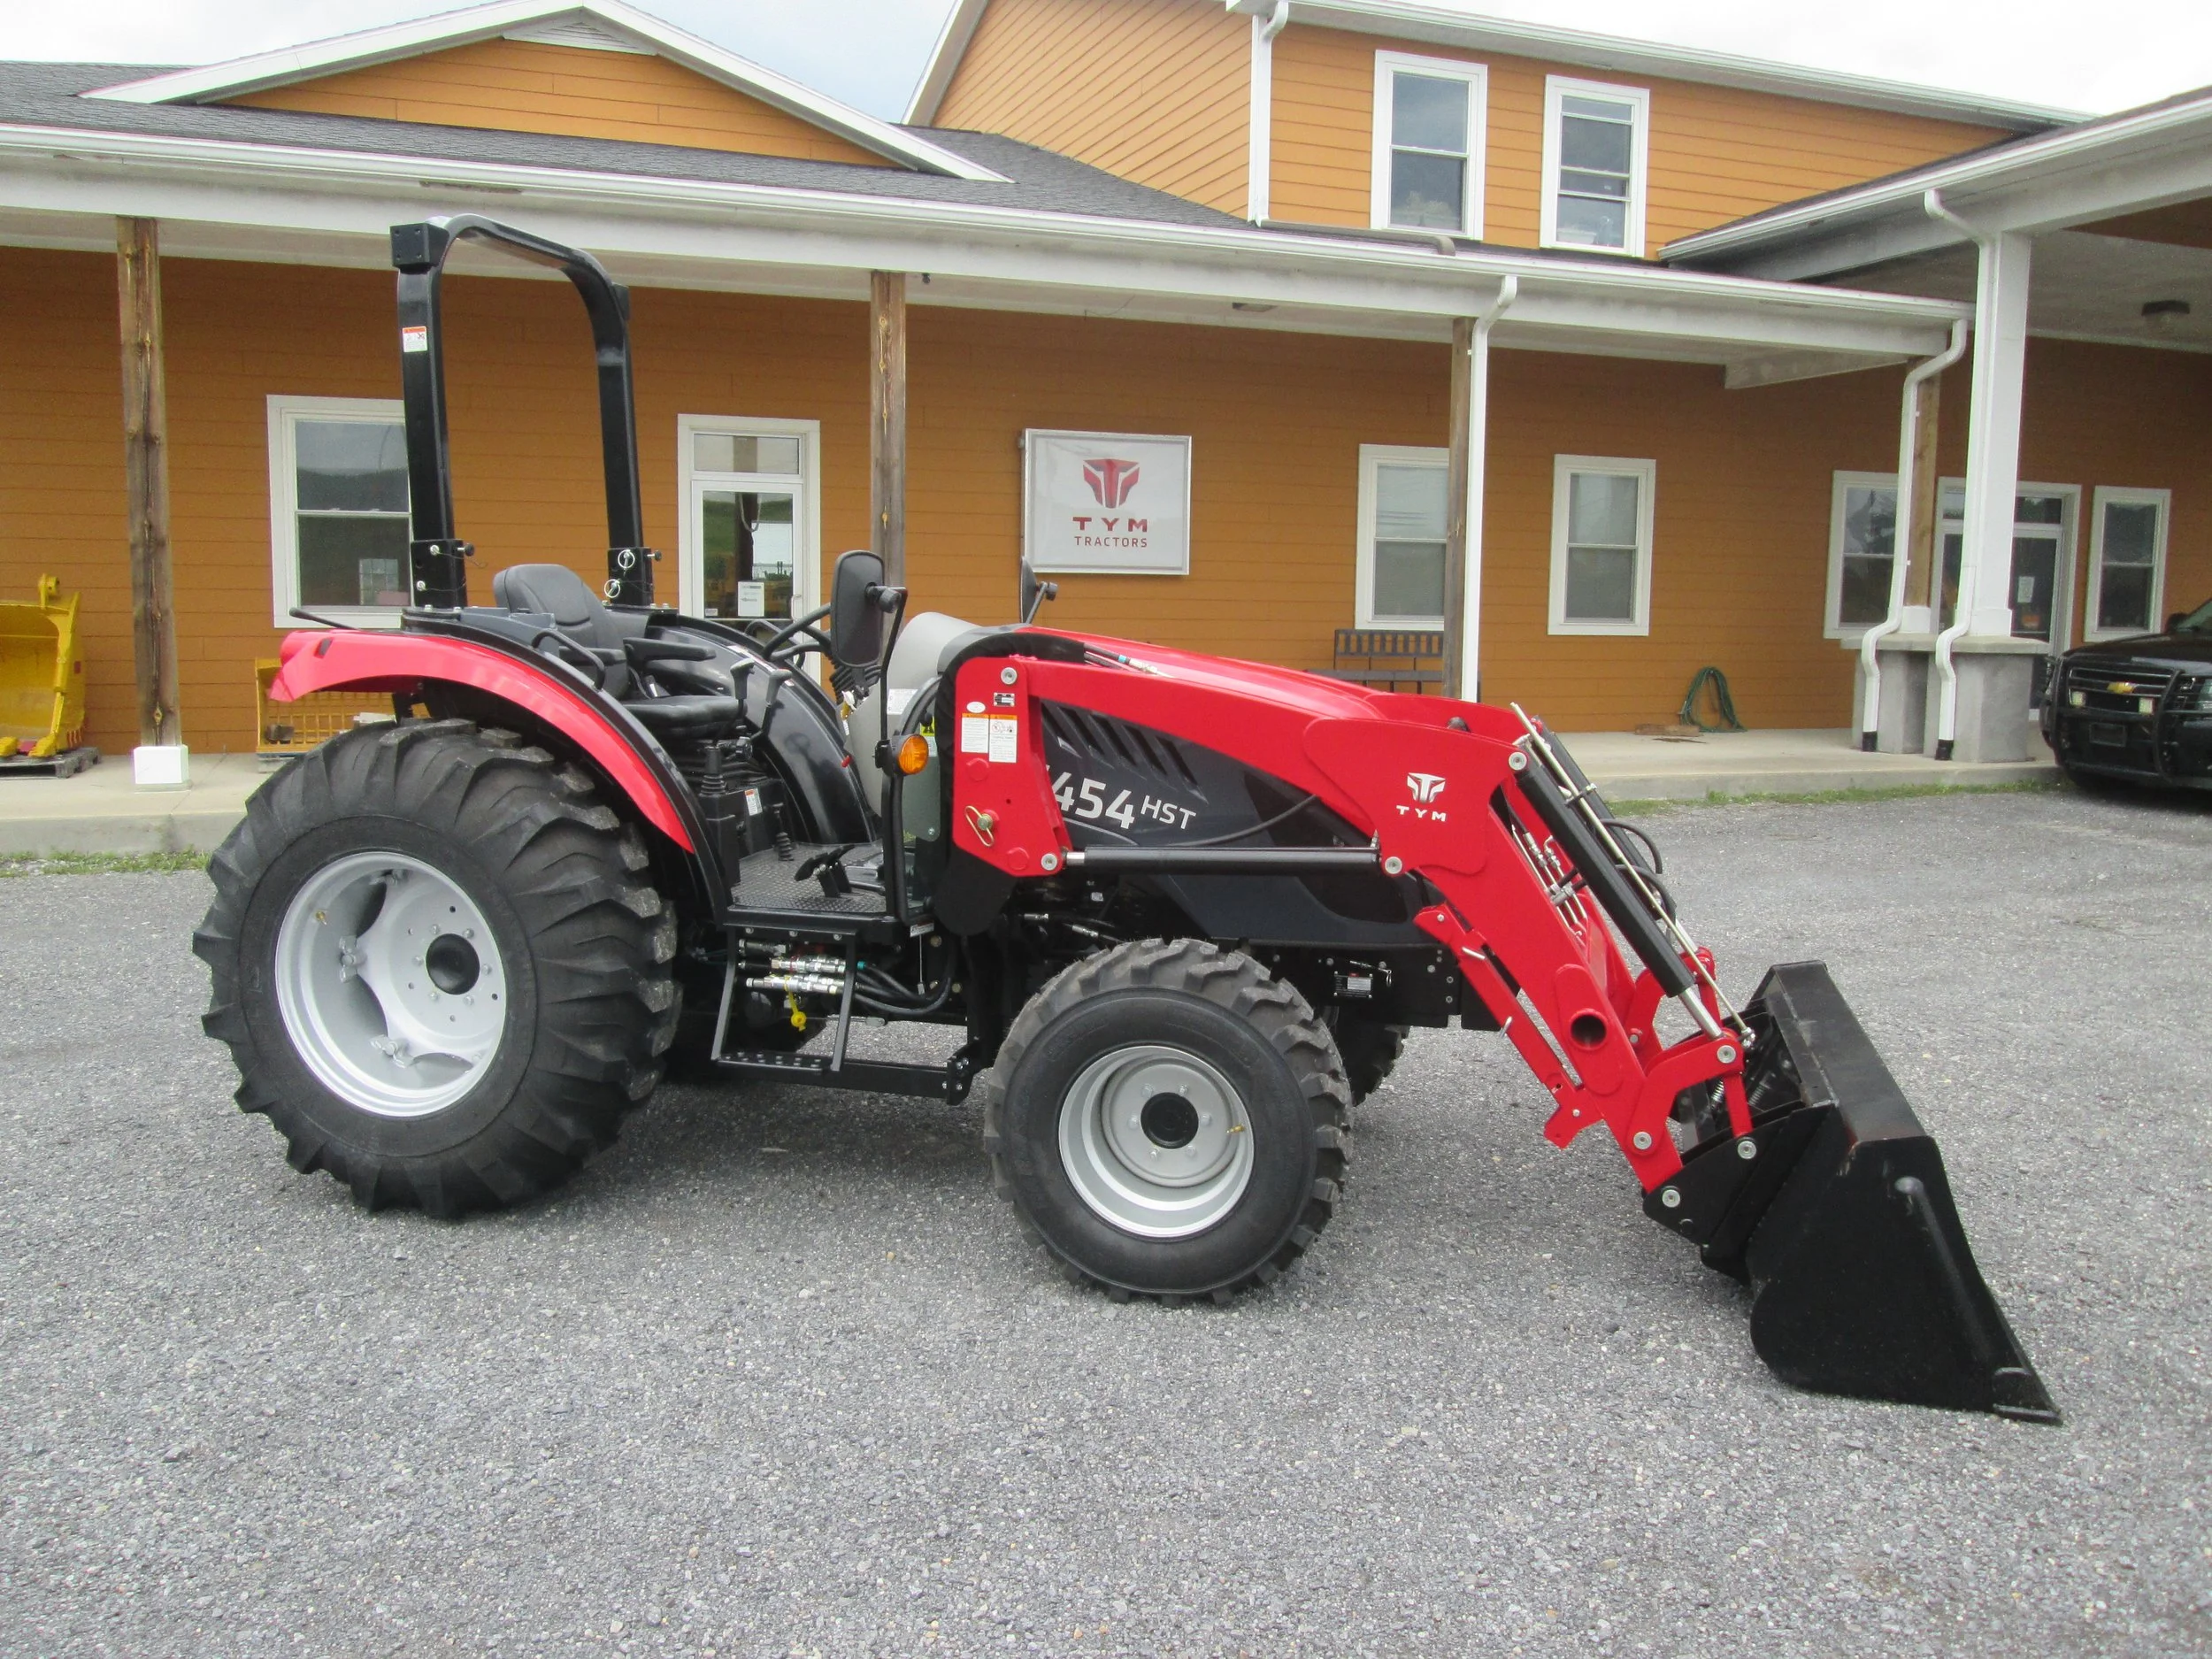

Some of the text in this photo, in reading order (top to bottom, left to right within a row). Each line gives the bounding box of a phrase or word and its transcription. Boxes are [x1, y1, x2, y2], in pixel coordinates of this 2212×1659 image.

[1072, 516, 1148, 533] TYM
[1074, 536, 1148, 548] TRACTORS
[1046, 764, 1197, 830] 454 HST
[1396, 804, 1447, 822] TYM
